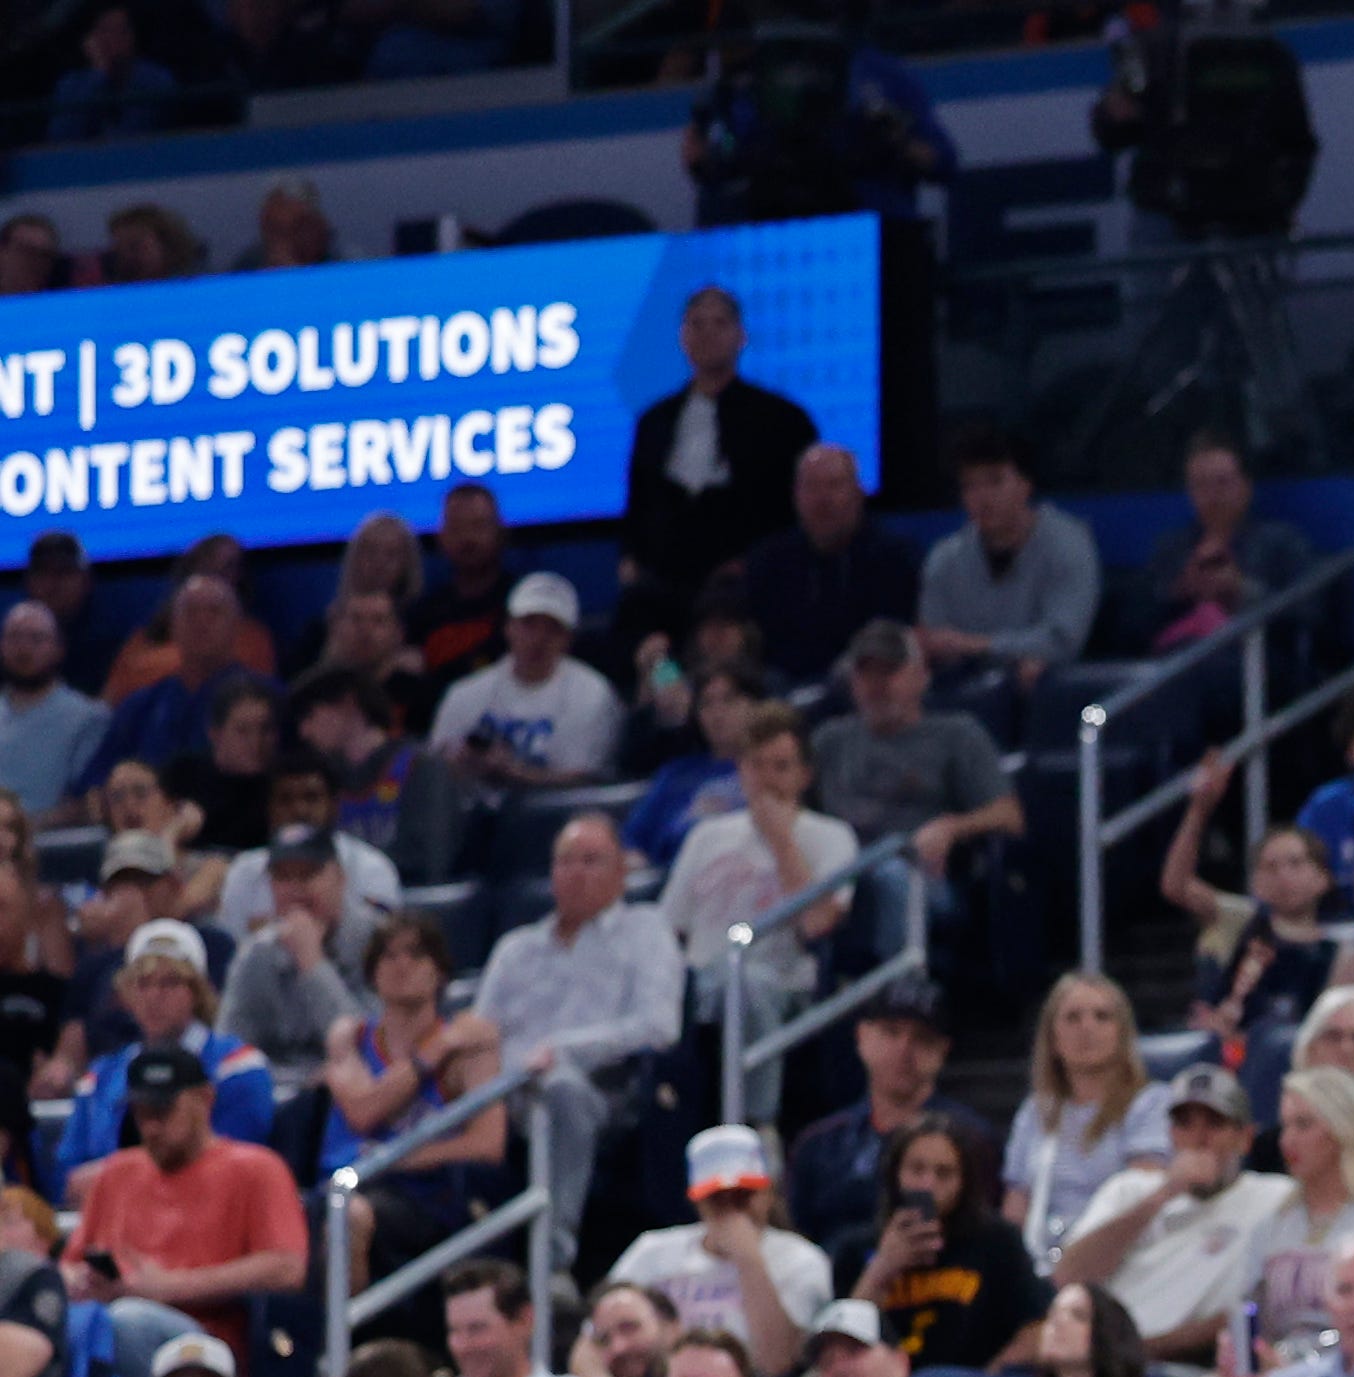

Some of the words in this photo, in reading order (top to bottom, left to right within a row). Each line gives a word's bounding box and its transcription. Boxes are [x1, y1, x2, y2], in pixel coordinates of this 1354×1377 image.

[112, 338, 196, 408] 3D
[208, 302, 580, 400] SOLUTIONS
[267, 403, 577, 493] SERVICES
